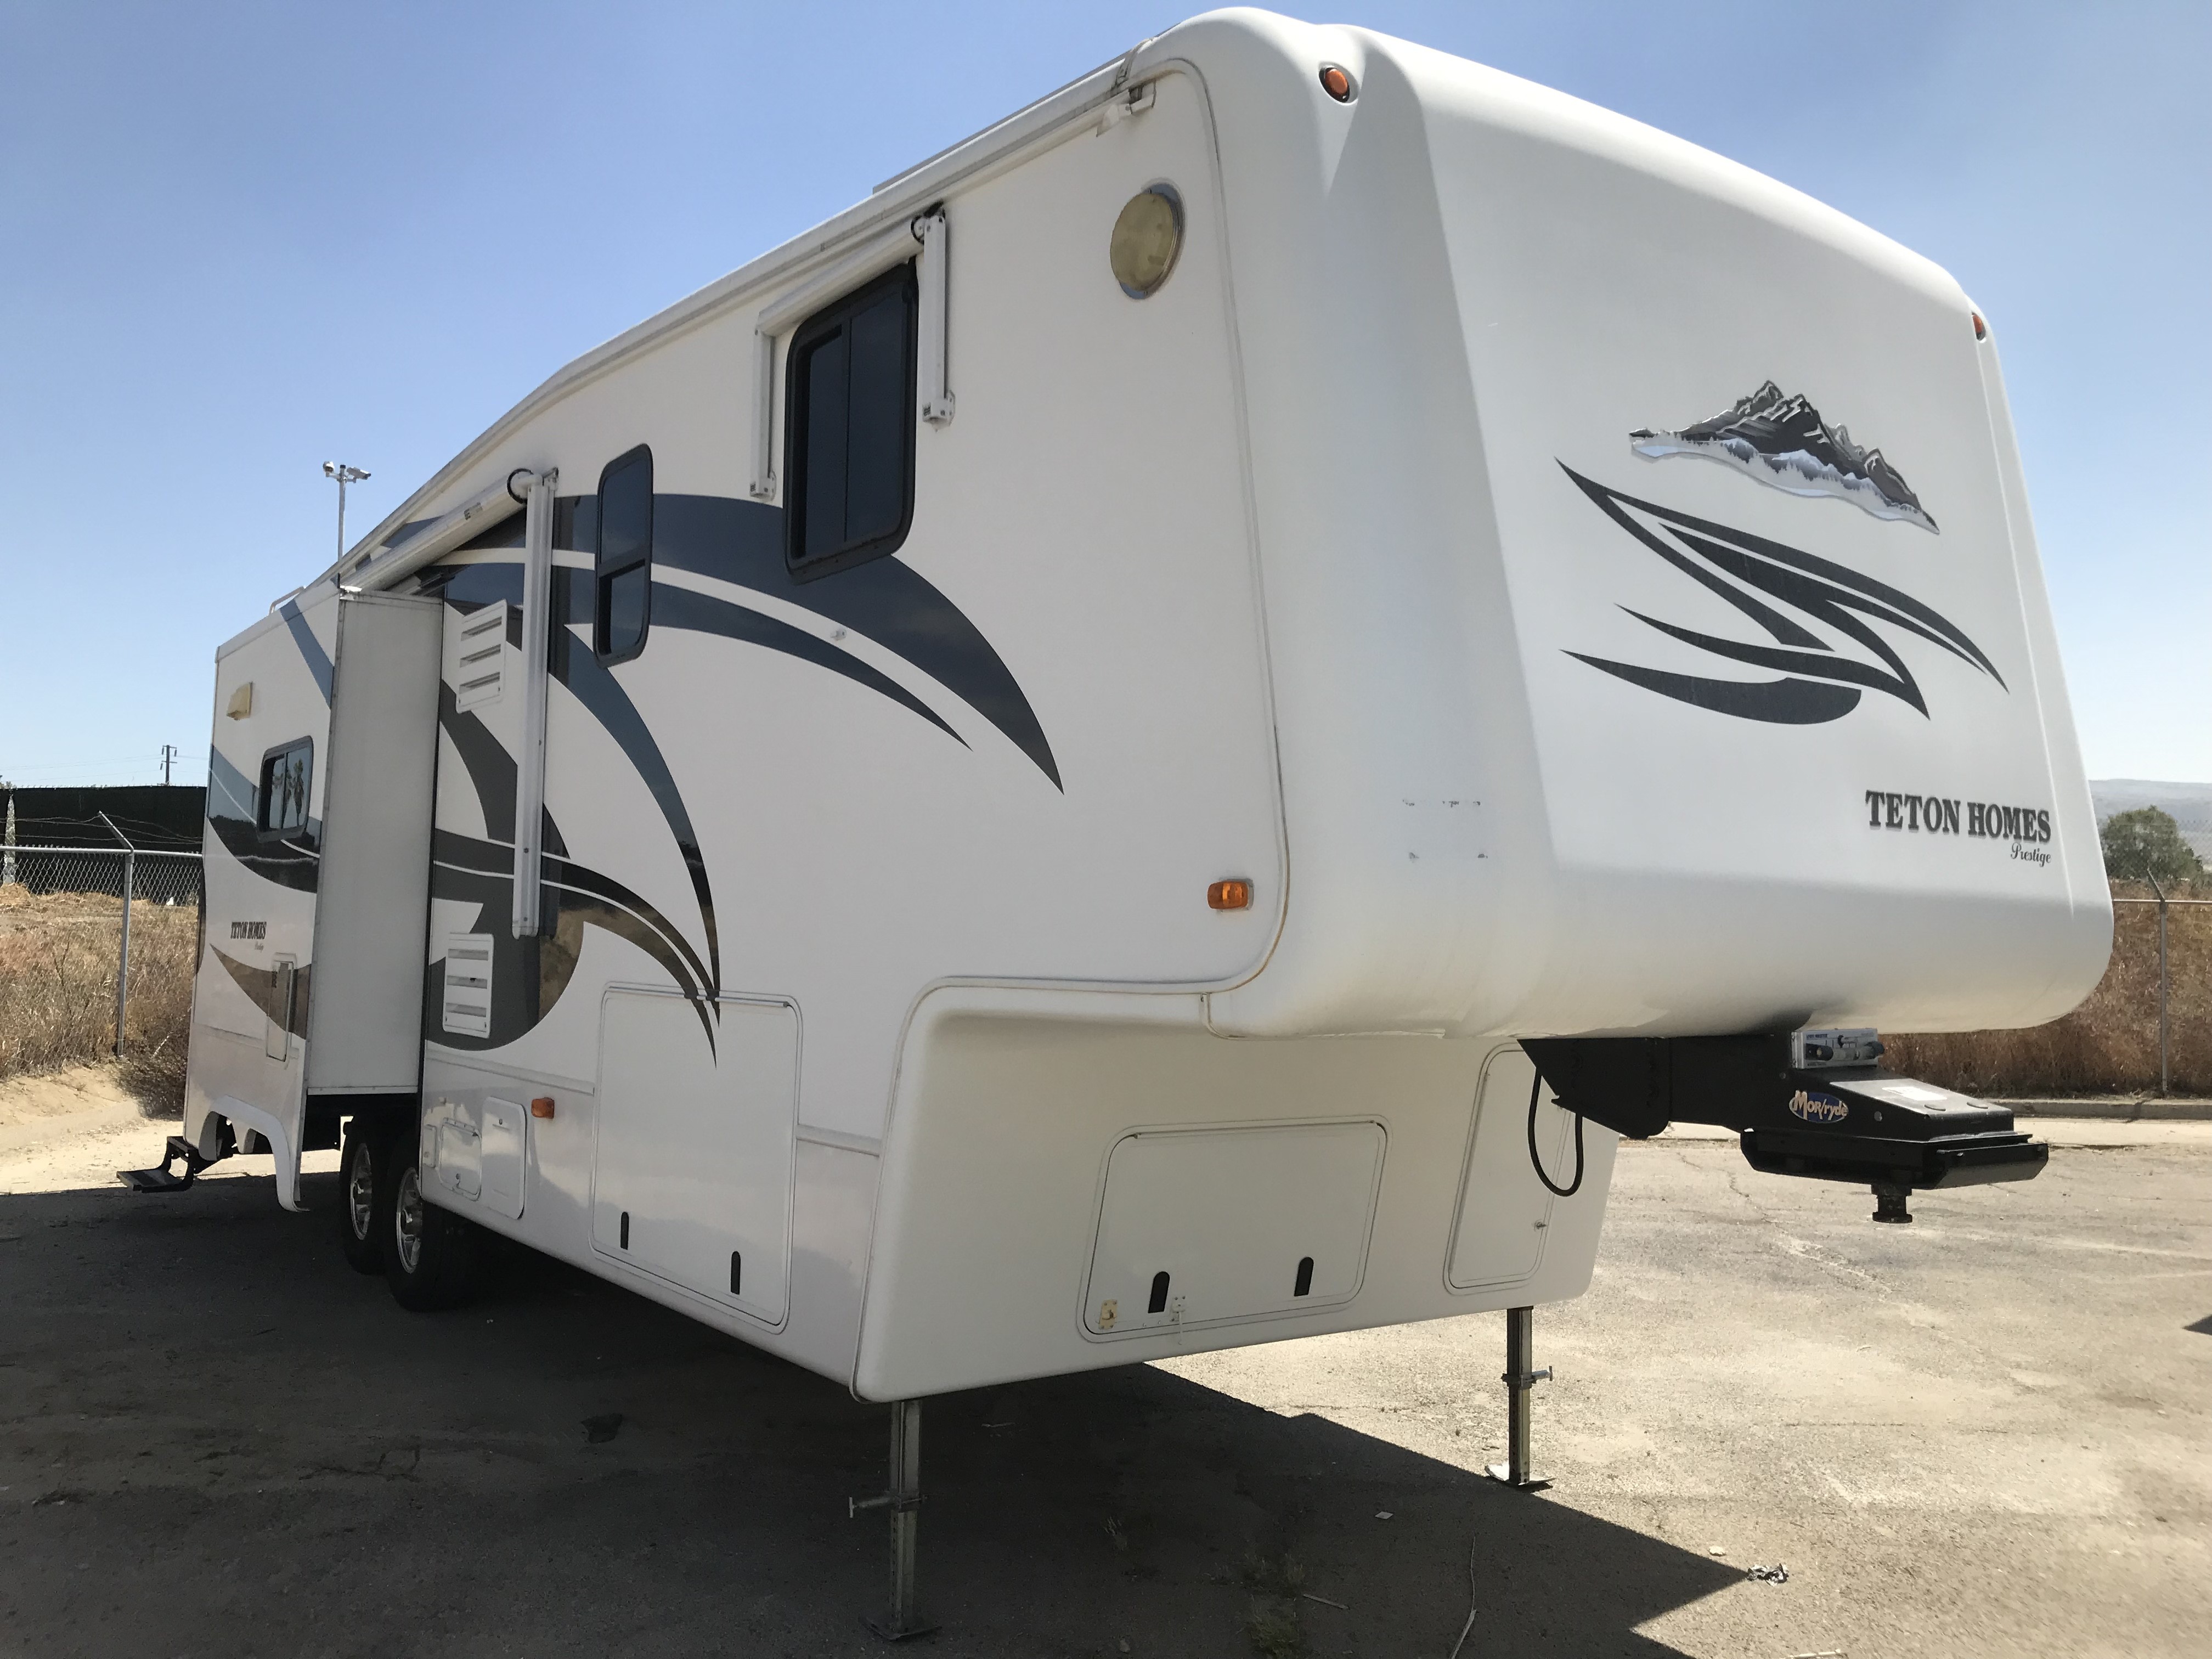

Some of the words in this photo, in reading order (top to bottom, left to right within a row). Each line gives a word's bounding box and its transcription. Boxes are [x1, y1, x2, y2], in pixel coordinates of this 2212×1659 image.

[1865, 789, 1961, 834] TETON
[1967, 801, 2051, 843] HOMES
[2010, 842, 2051, 867] Prestige
